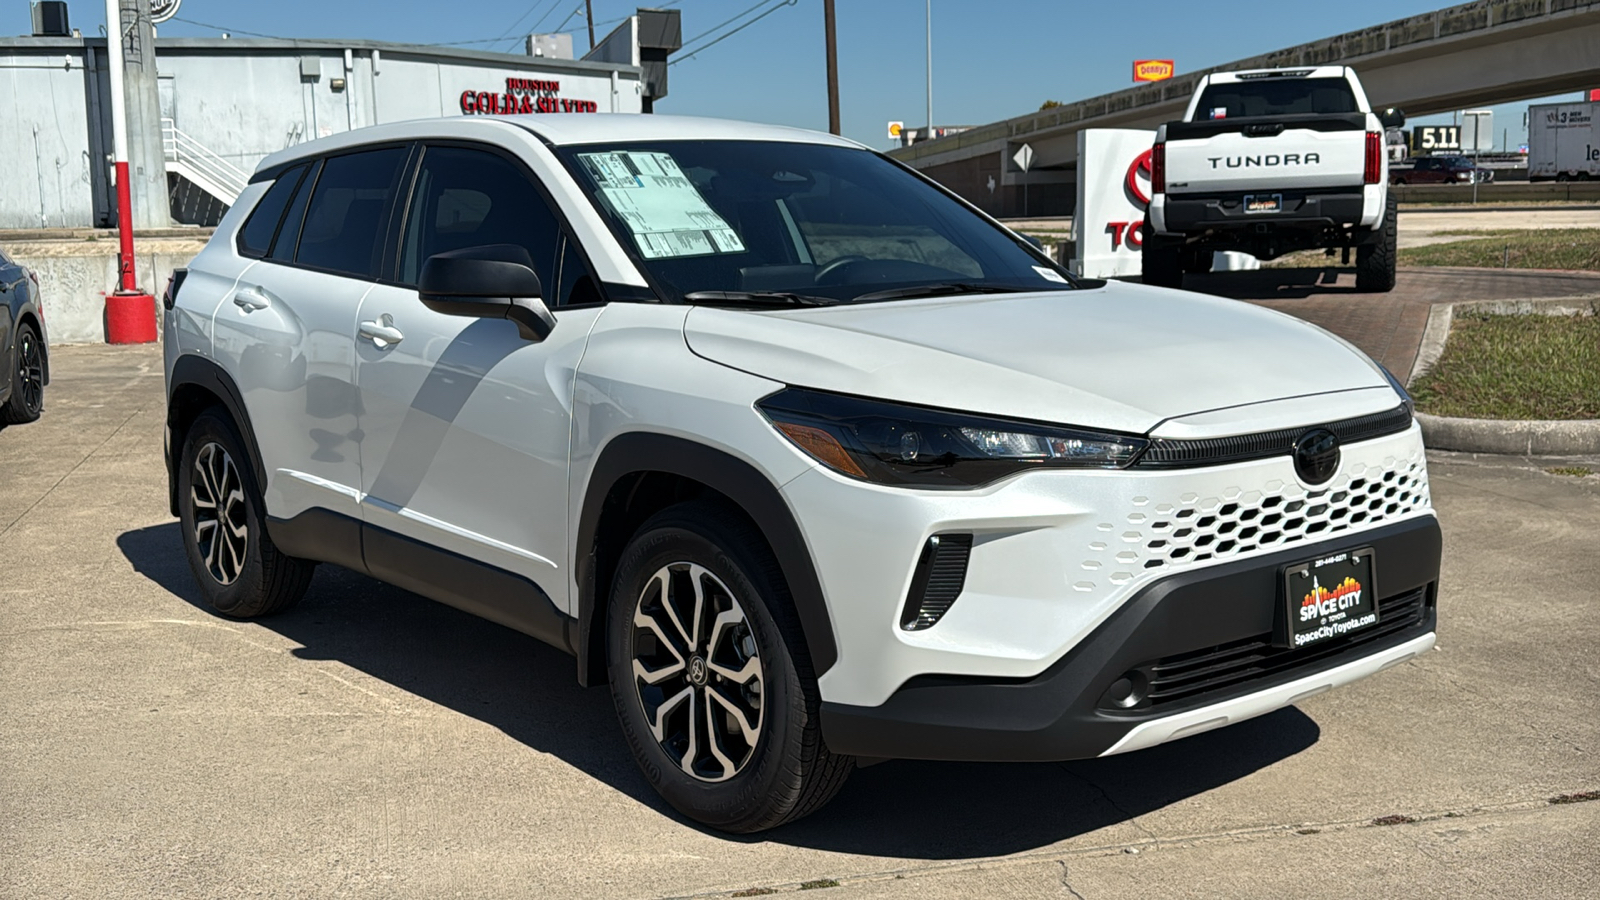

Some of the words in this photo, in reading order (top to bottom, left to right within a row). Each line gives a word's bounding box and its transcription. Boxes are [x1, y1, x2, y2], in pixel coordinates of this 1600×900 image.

[1141, 65, 1168, 76] Denny's
[507, 77, 560, 92] HOUSTON
[460, 89, 519, 114] GOLD
[520, 94, 535, 114] &
[537, 96, 598, 114] SILVER
[1561, 112, 1568, 123] 3
[1422, 127, 1460, 149] 5.11
[1207, 153, 1320, 169] TUNDRA
[1300, 596, 1338, 621] SPACE
[1338, 590, 1361, 609] CITY
[1328, 611, 1347, 622] TOYOTA
[1295, 614, 1375, 645] SpaceCityToyota.com
